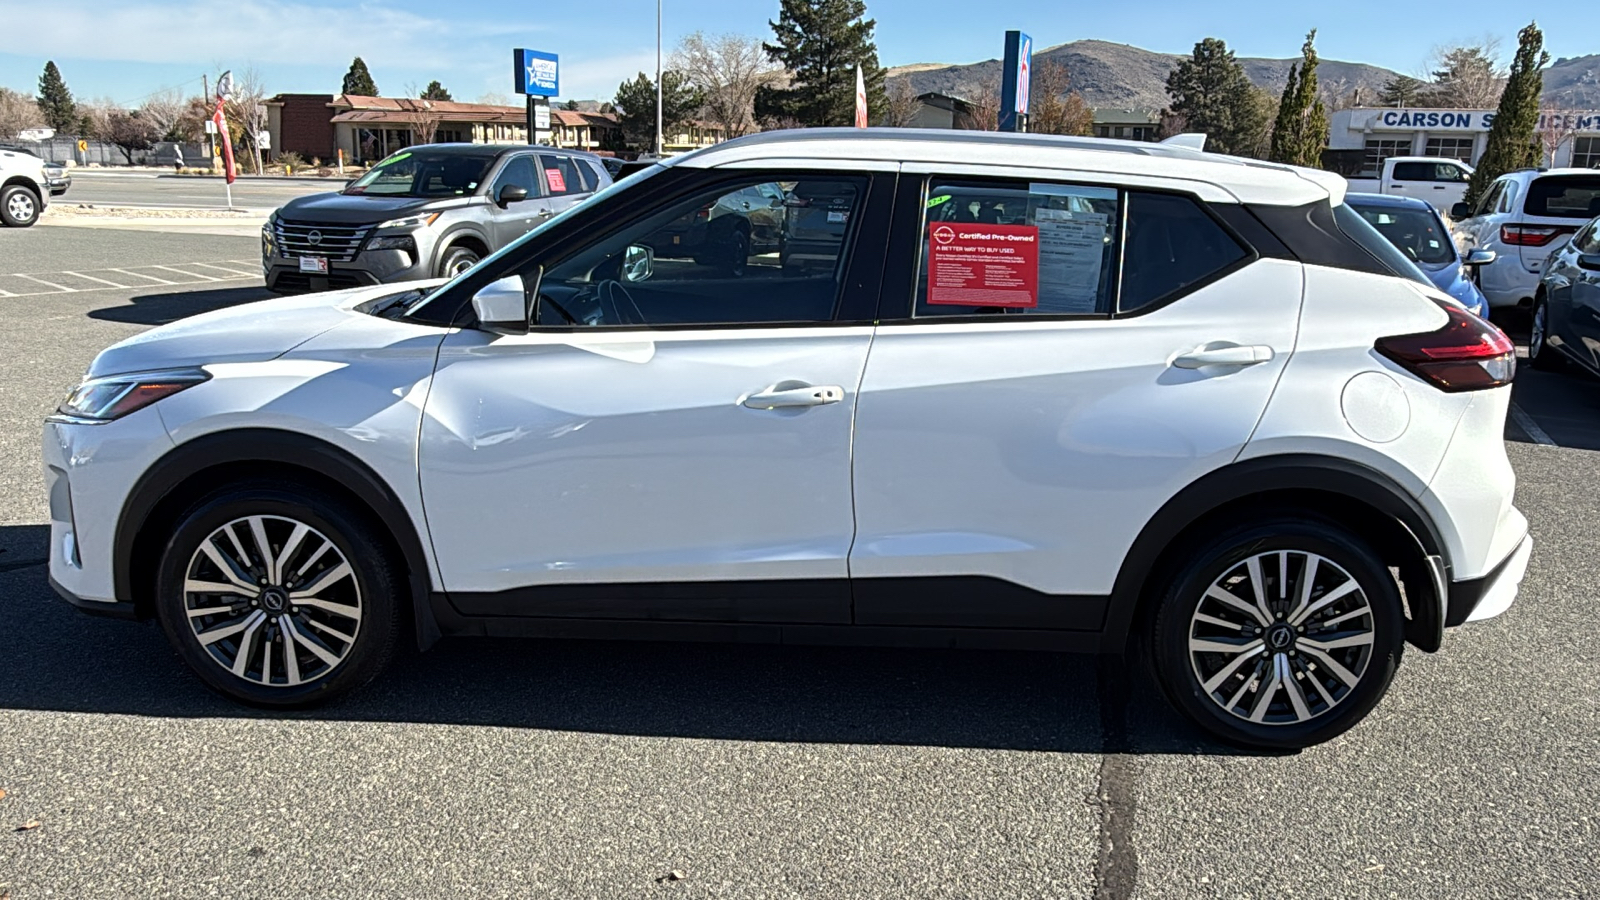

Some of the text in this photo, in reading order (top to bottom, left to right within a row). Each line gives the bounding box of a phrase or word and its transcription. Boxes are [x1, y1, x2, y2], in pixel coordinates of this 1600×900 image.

[1384, 111, 1471, 128] CARSON
[959, 232, 991, 240] Certified
[991, 233, 1034, 242] Pre-Owned
